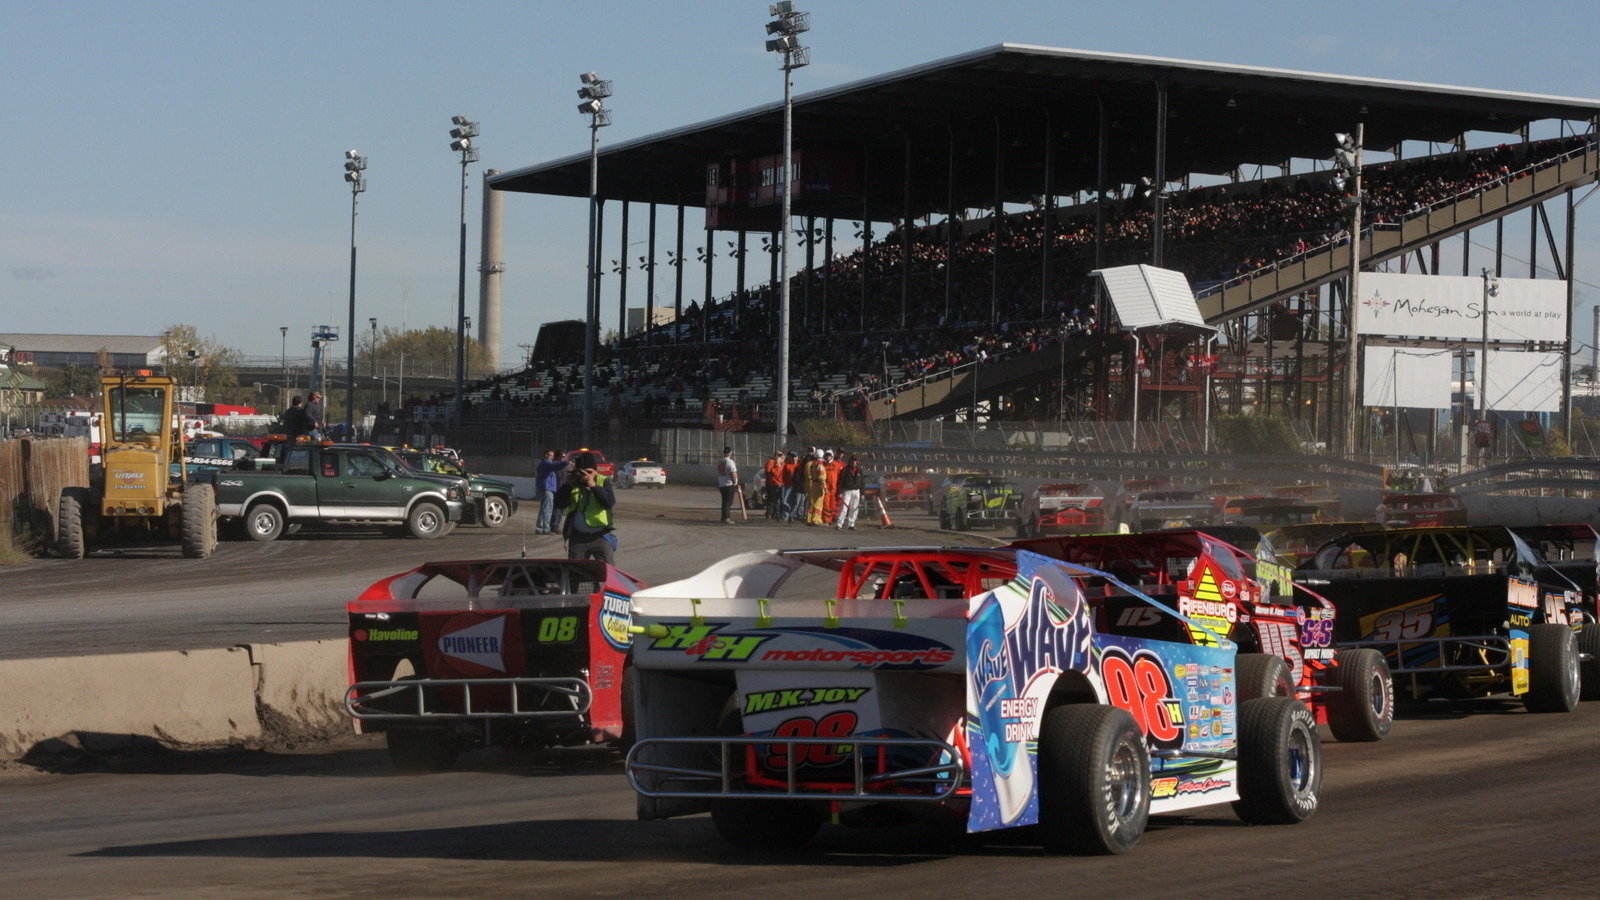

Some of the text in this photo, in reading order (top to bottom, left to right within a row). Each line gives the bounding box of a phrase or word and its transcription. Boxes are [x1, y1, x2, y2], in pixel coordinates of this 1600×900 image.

[1393, 299, 1462, 318] Mohegan
[1179, 596, 1237, 624] RIFENBURG
[538, 616, 578, 643] 08
[1510, 614, 1530, 626] AUTO
[369, 629, 418, 641] Havoline
[1005, 577, 1092, 702] WAVE
[442, 636, 500, 654] PIONEER
[760, 649, 955, 665] motorsports
[1001, 698, 1038, 717] ENERGY
[1102, 656, 1180, 741] 98
[1005, 723, 1034, 742] DRINK
